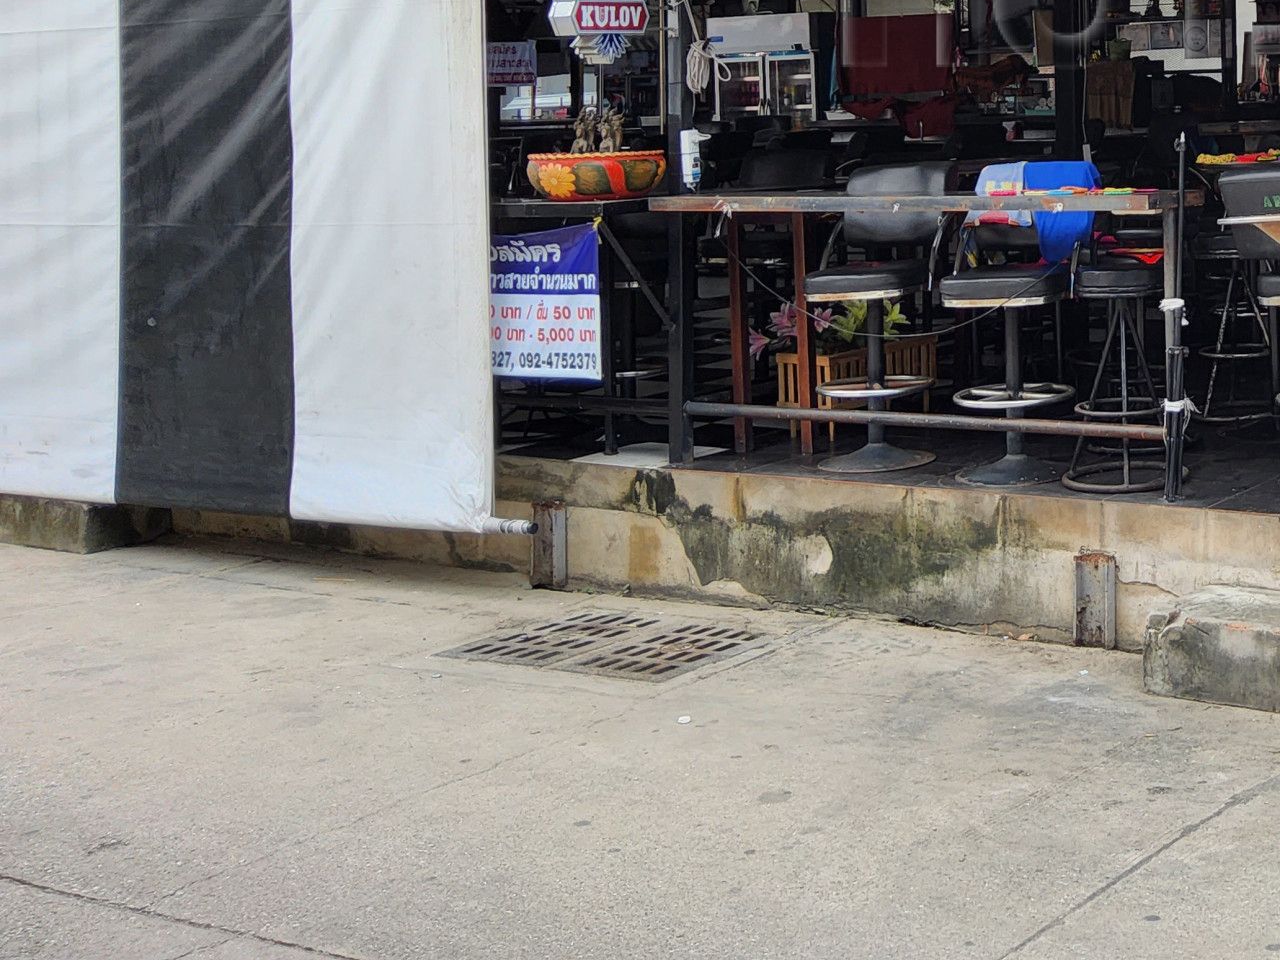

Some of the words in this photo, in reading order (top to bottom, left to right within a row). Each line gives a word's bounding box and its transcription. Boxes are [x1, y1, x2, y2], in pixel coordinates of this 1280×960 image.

[580, 4, 643, 28] KULOV
[553, 305, 572, 320] 50
[537, 328, 575, 345] 5,000
